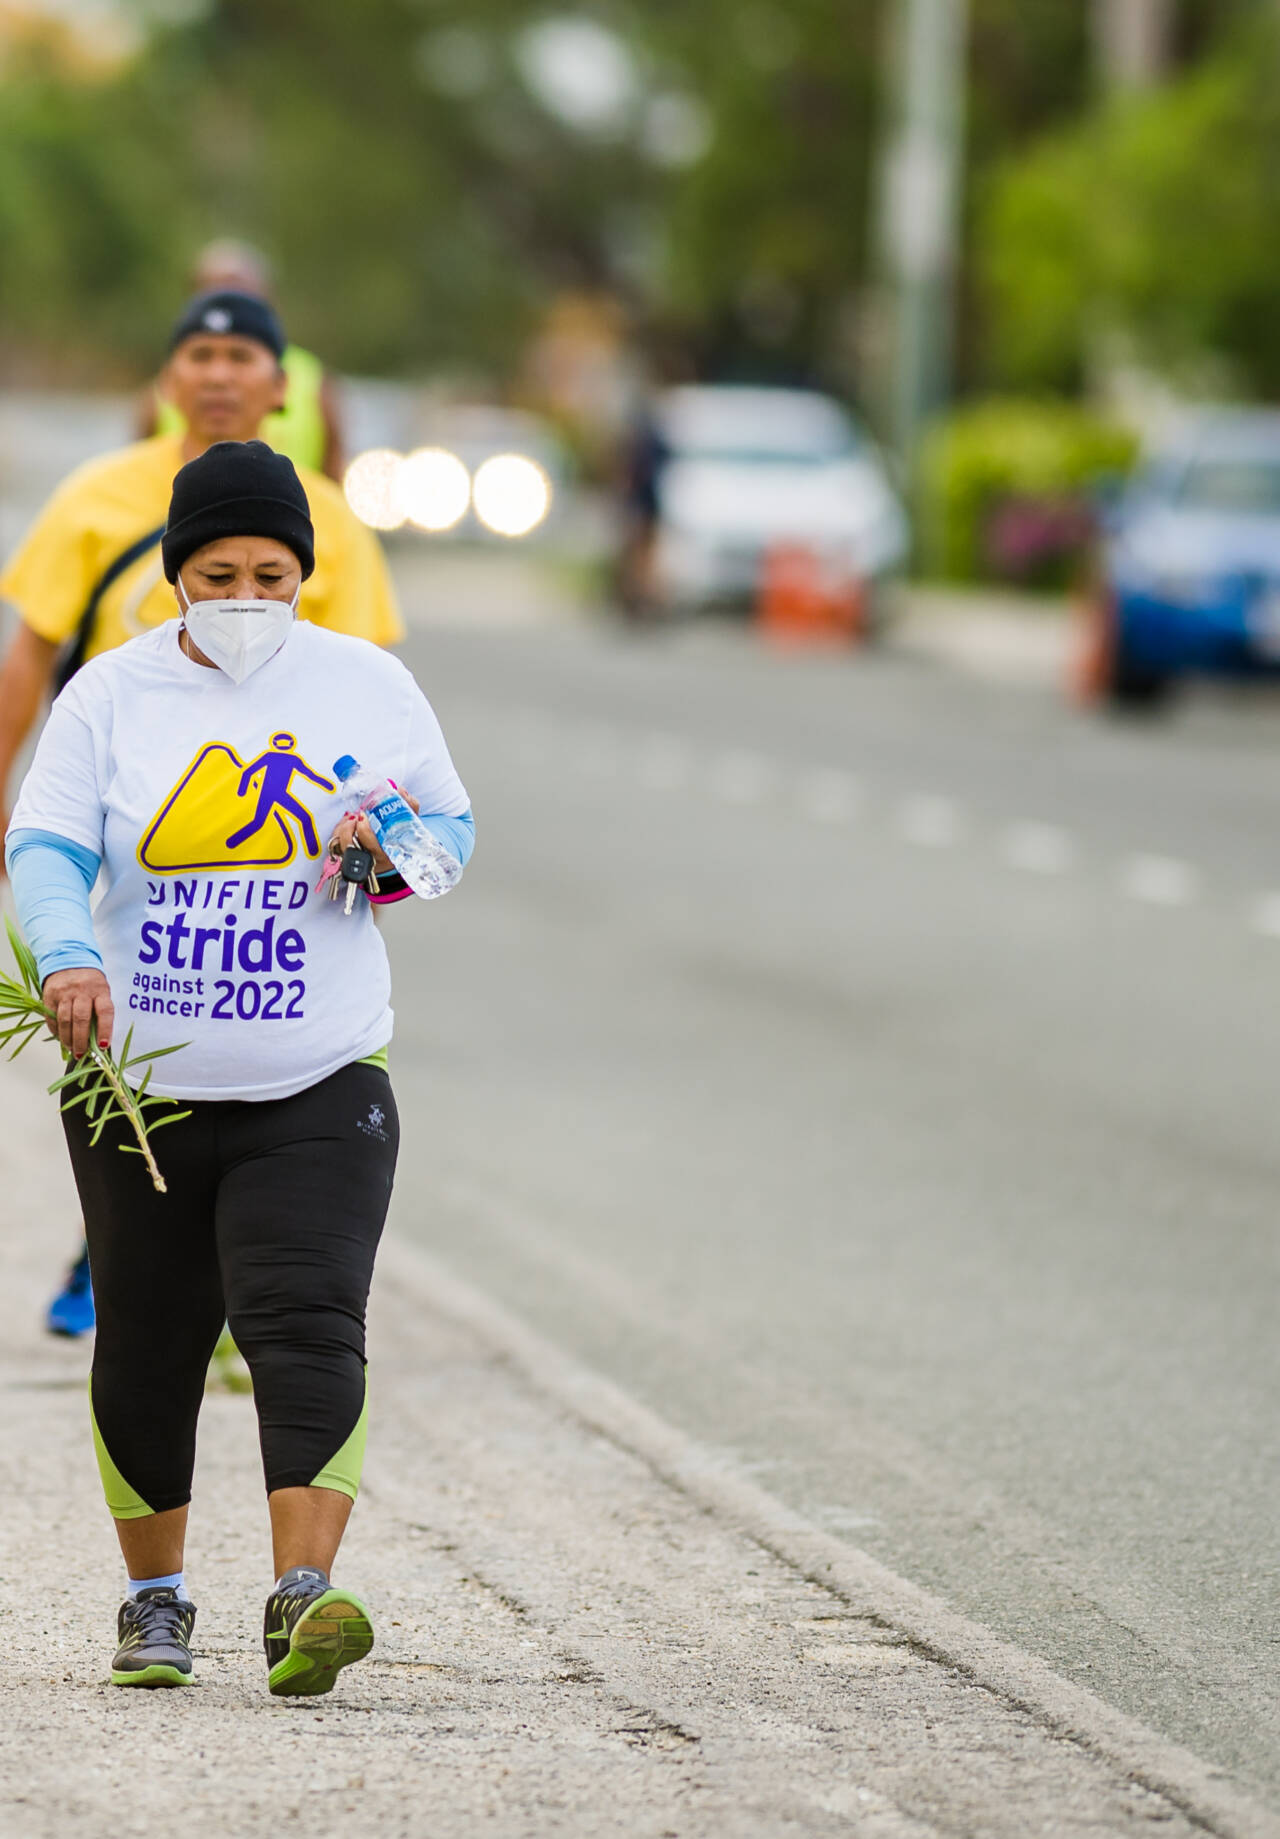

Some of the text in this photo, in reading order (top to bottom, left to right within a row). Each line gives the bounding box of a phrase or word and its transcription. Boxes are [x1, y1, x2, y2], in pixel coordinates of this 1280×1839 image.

[147, 879, 309, 911] UNIFIED
[138, 912, 307, 973] stride
[128, 979, 306, 1021] cancer 2022
[132, 972, 205, 995] against
